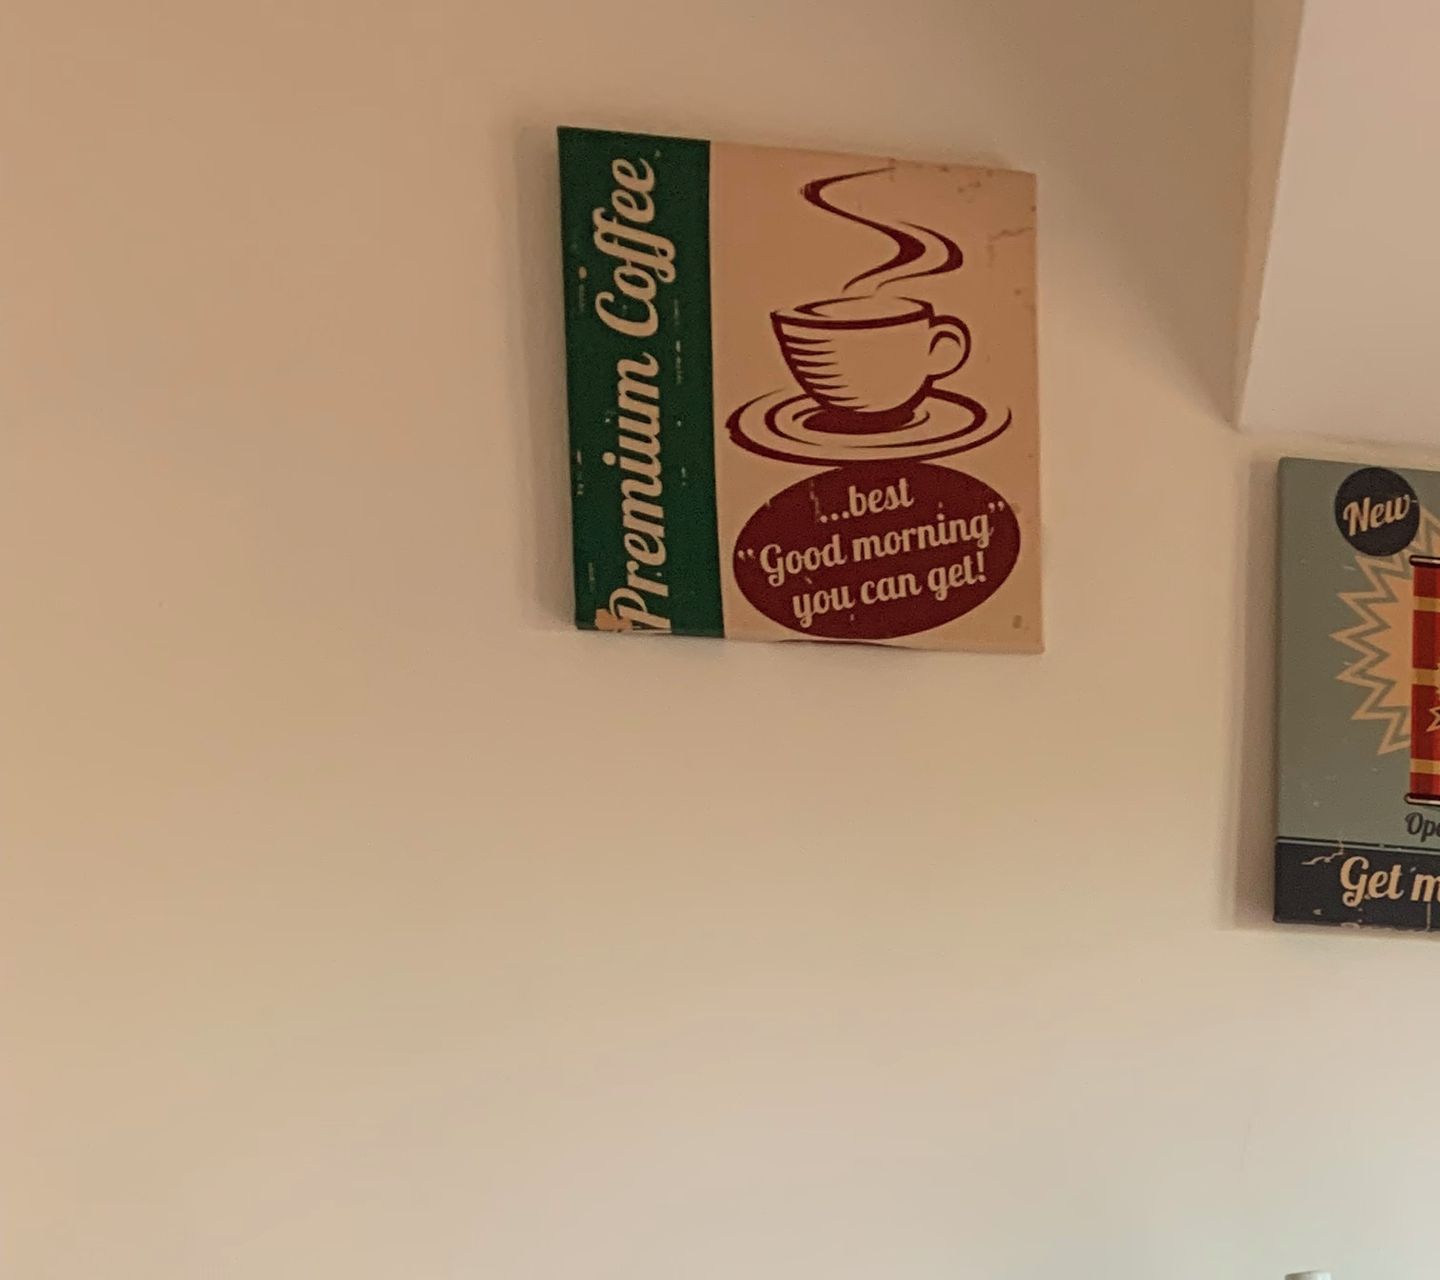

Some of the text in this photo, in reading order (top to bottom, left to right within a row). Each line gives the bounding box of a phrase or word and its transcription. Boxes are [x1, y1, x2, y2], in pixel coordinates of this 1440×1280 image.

[592, 156, 677, 633] Premium Coffee
[1342, 493, 1412, 537] New
[792, 550, 988, 628] you can get!
[1338, 855, 1407, 907] Get
